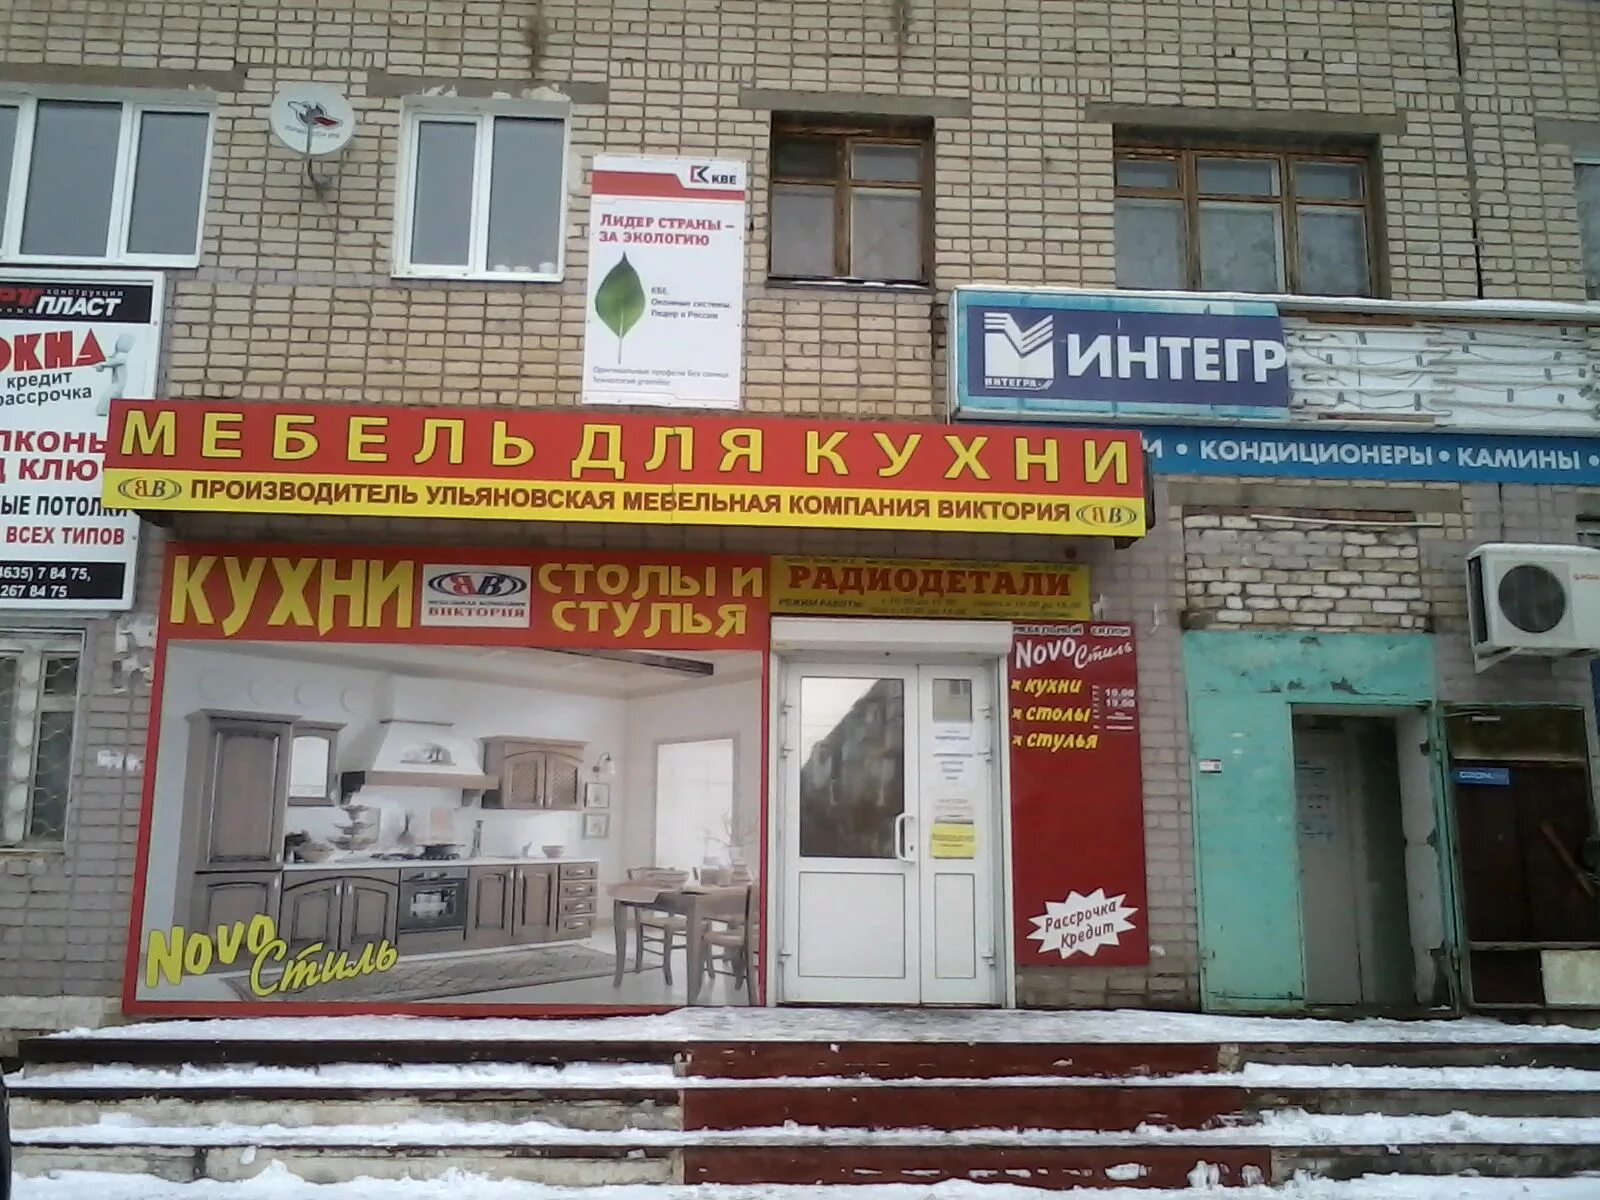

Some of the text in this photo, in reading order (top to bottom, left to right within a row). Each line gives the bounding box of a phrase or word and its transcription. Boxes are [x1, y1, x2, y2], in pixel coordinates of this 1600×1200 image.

[598, 231, 710, 246] ЗА ЭКОЛОГИЮ
[35, 296, 122, 316] ПЛАСТ
[1067, 333, 1288, 383] ИНТЕГР
[7, 372, 73, 391] кредит
[120, 409, 1129, 484] МЕБЕЛЬ ДЛЯ КУХНИ
[1200, 439, 1433, 466] КОНДИЦИОНЕРЫ
[1456, 446, 1581, 470] КАМИНЫ
[190, 479, 419, 505] ПРОИЗВОДИТЕЛЬ
[425, 485, 615, 510] УЛЬЯНОВСКАЯ
[623, 491, 782, 514] МЕБЕЛЬНАЯ
[788, 495, 930, 518] КОМПАНИЯ
[937, 500, 1071, 522] ВИКТОРИЯ
[6, 526, 125, 545] ВСЕХ ТИПОВ
[37, 567, 46, 579] 7
[50, 567, 66, 579] 84
[537, 563, 763, 600] СТОЛЫ И
[788, 564, 1071, 598] РАДИОДЕТАЛИ
[1, 586, 68, 598] 267 84 75
[169, 554, 415, 637] КУХНИ
[551, 600, 748, 639] СТУЛЬЯ
[1045, 901, 1117, 933] Рассрочка
[1060, 922, 1115, 949] Кредит
[250, 938, 400, 998] Стиль
